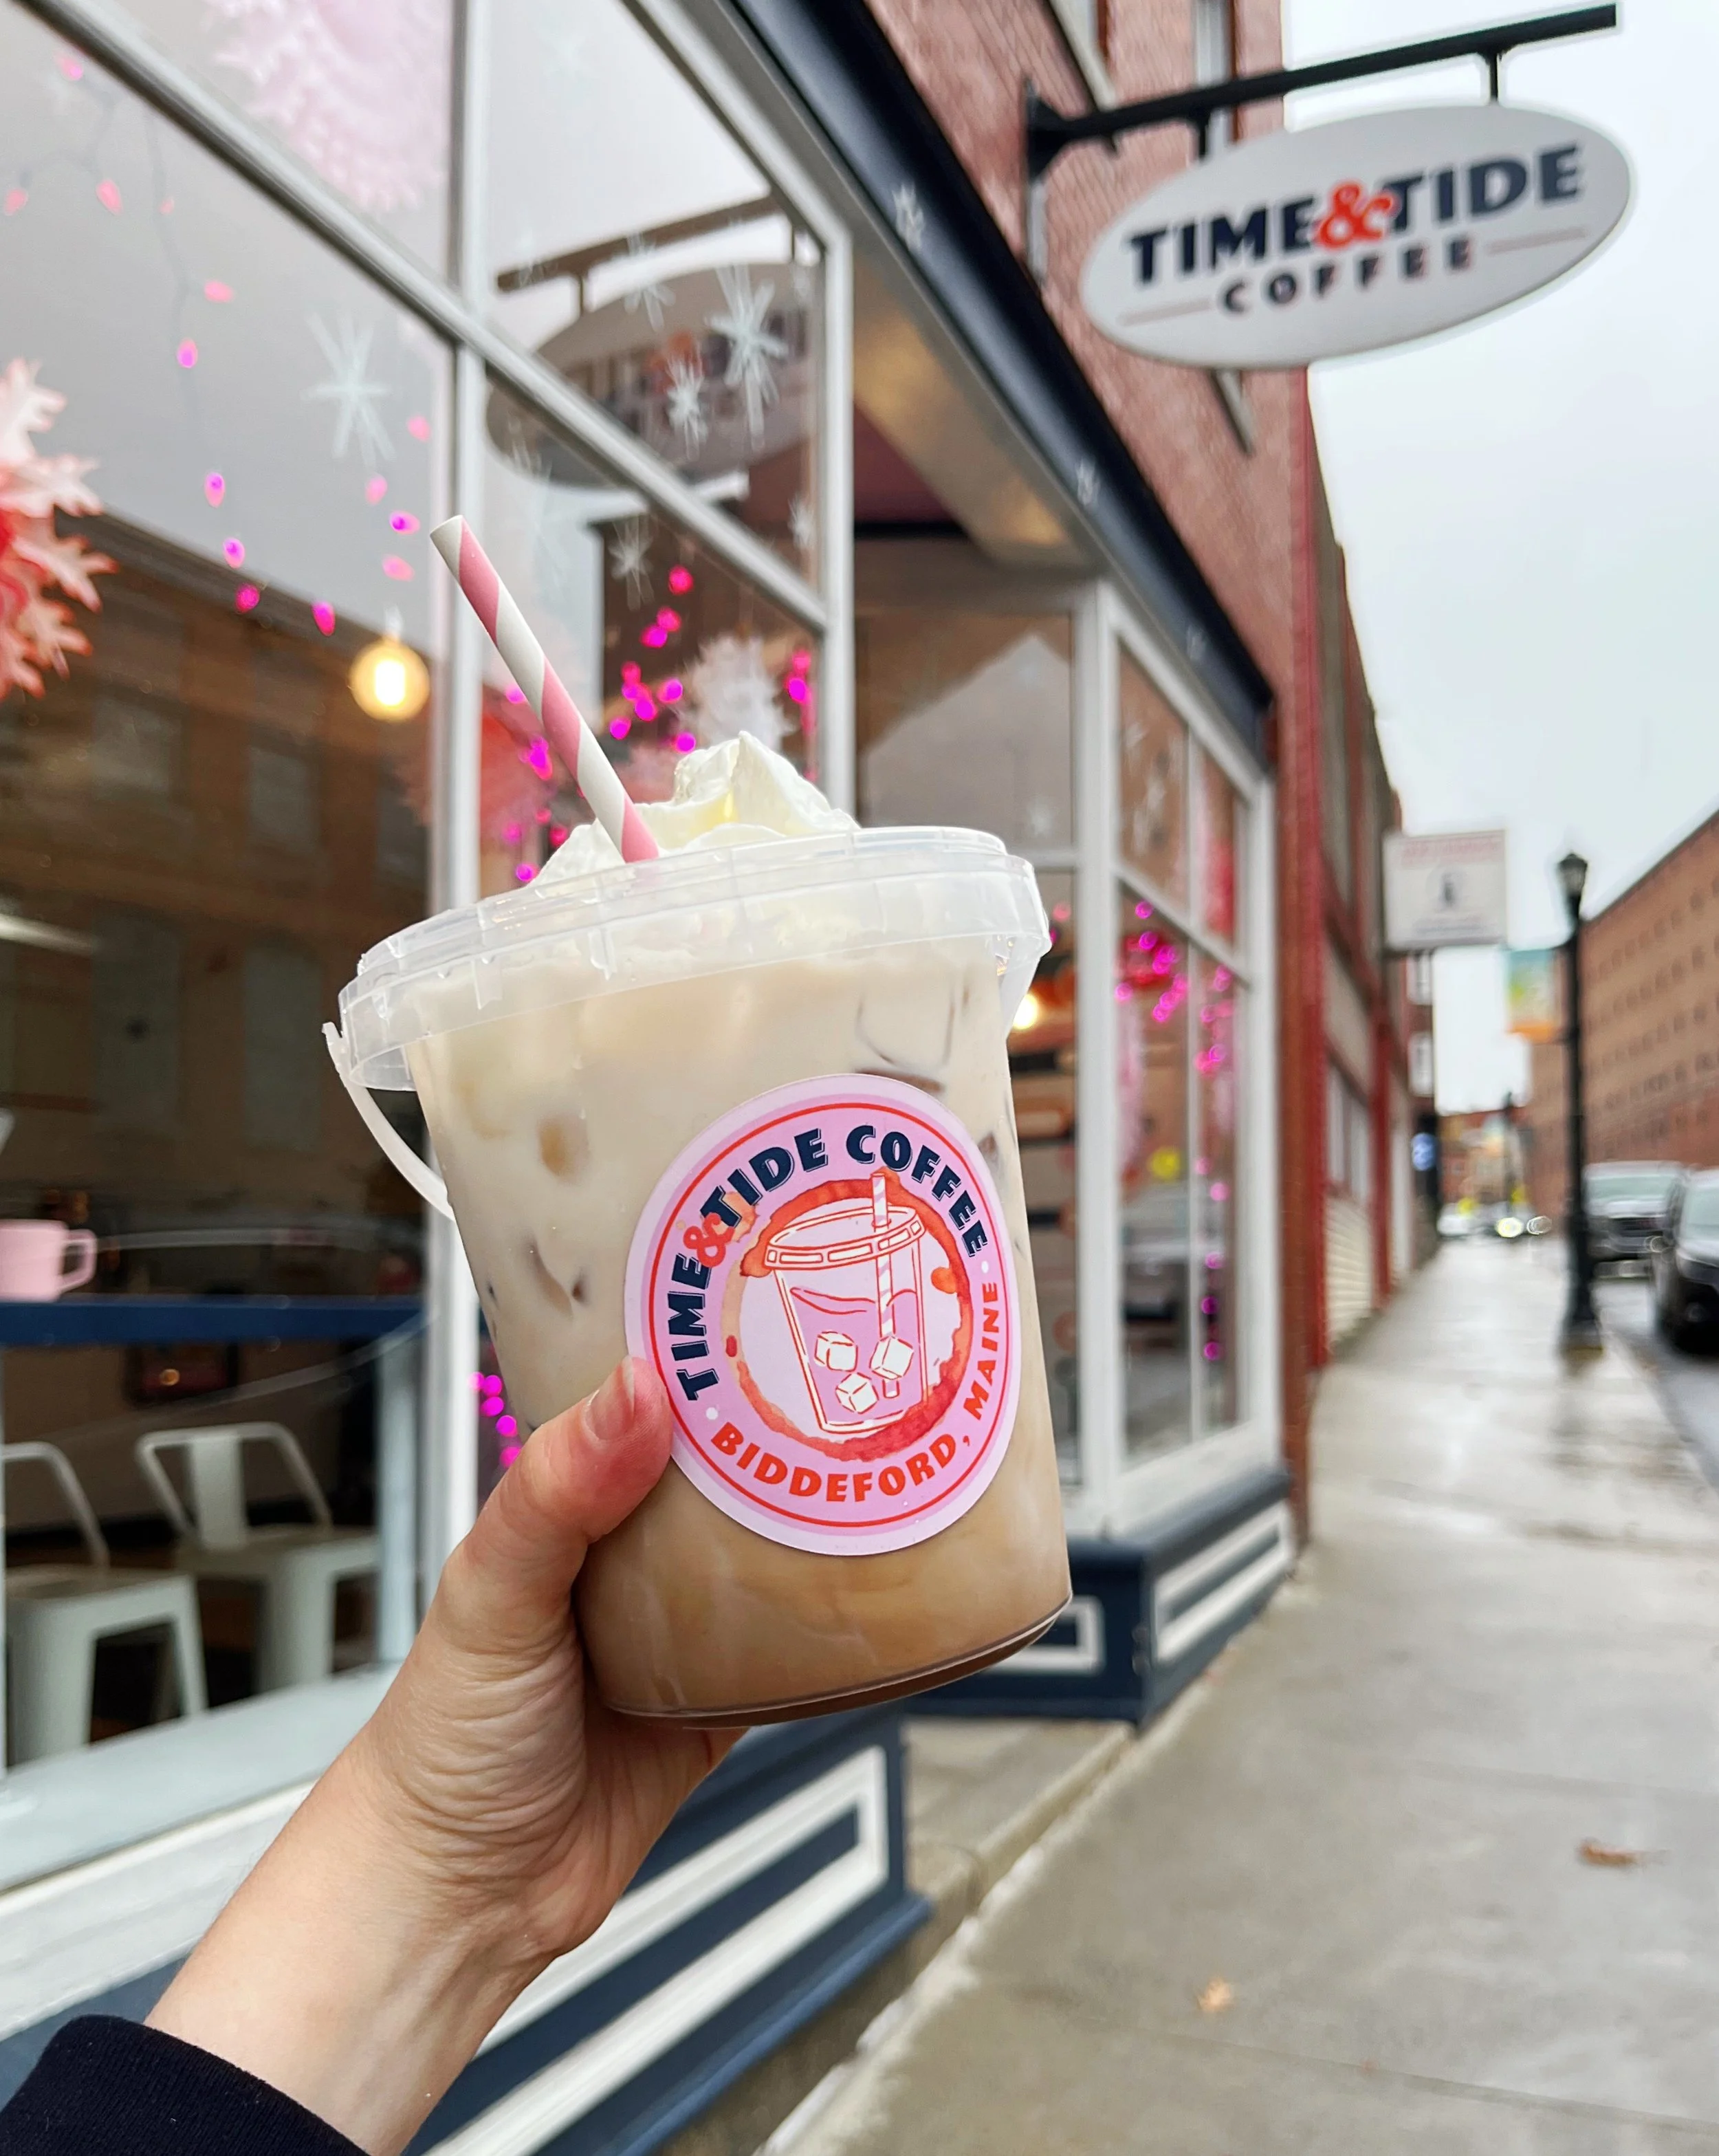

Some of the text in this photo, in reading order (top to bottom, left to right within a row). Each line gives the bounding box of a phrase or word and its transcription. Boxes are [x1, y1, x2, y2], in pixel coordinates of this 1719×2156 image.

[1220, 238, 1474, 314] COFFEE
[846, 1125, 987, 1258] COFFEE
[710, 1281, 998, 1503] BIDDEFORD, MAINE
